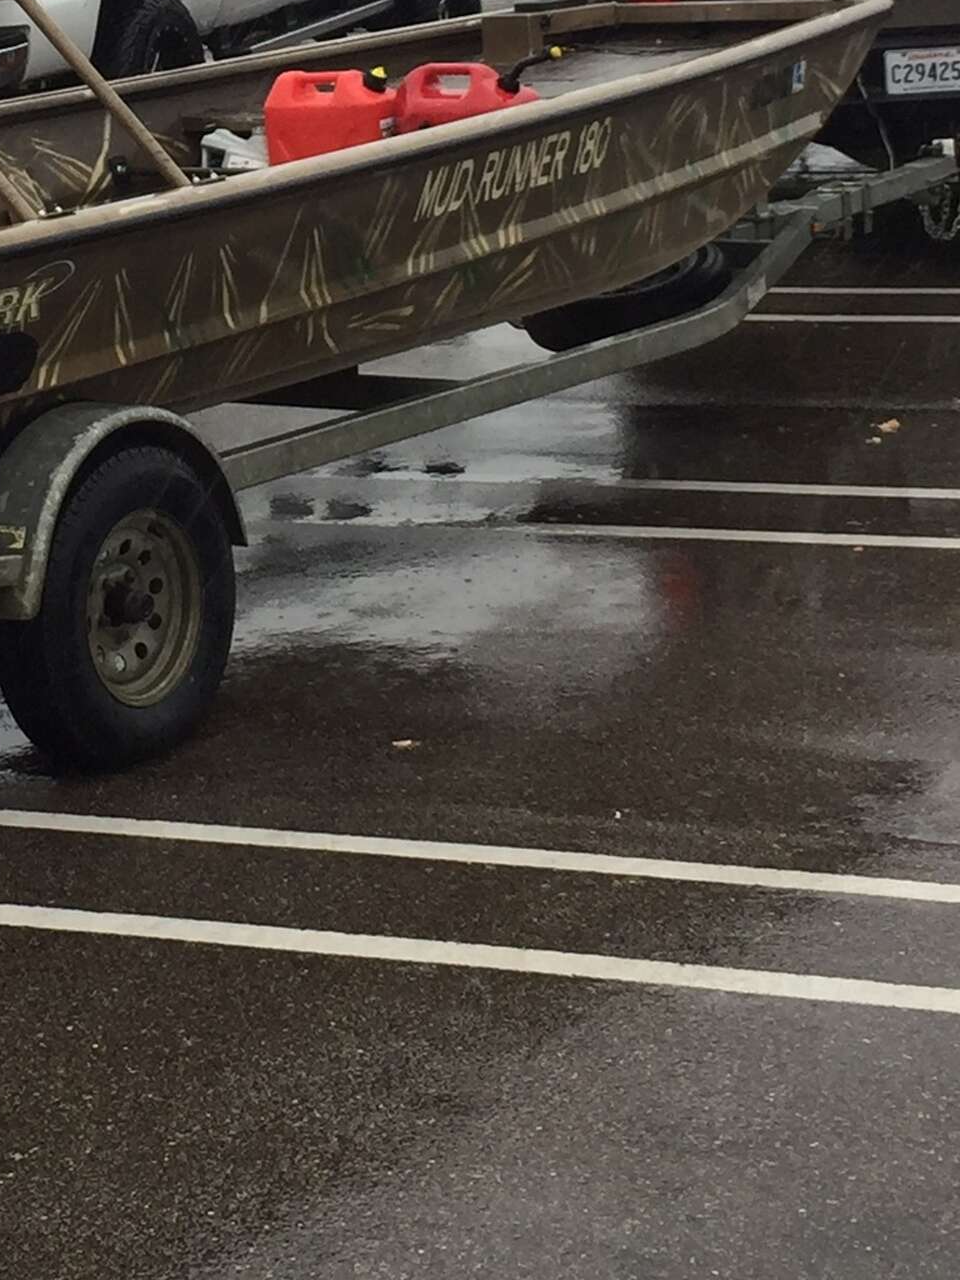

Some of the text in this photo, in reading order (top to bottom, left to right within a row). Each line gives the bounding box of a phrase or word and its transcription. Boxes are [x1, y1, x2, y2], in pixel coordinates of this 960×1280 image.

[413, 116, 613, 223] MUD RUNNER 180
